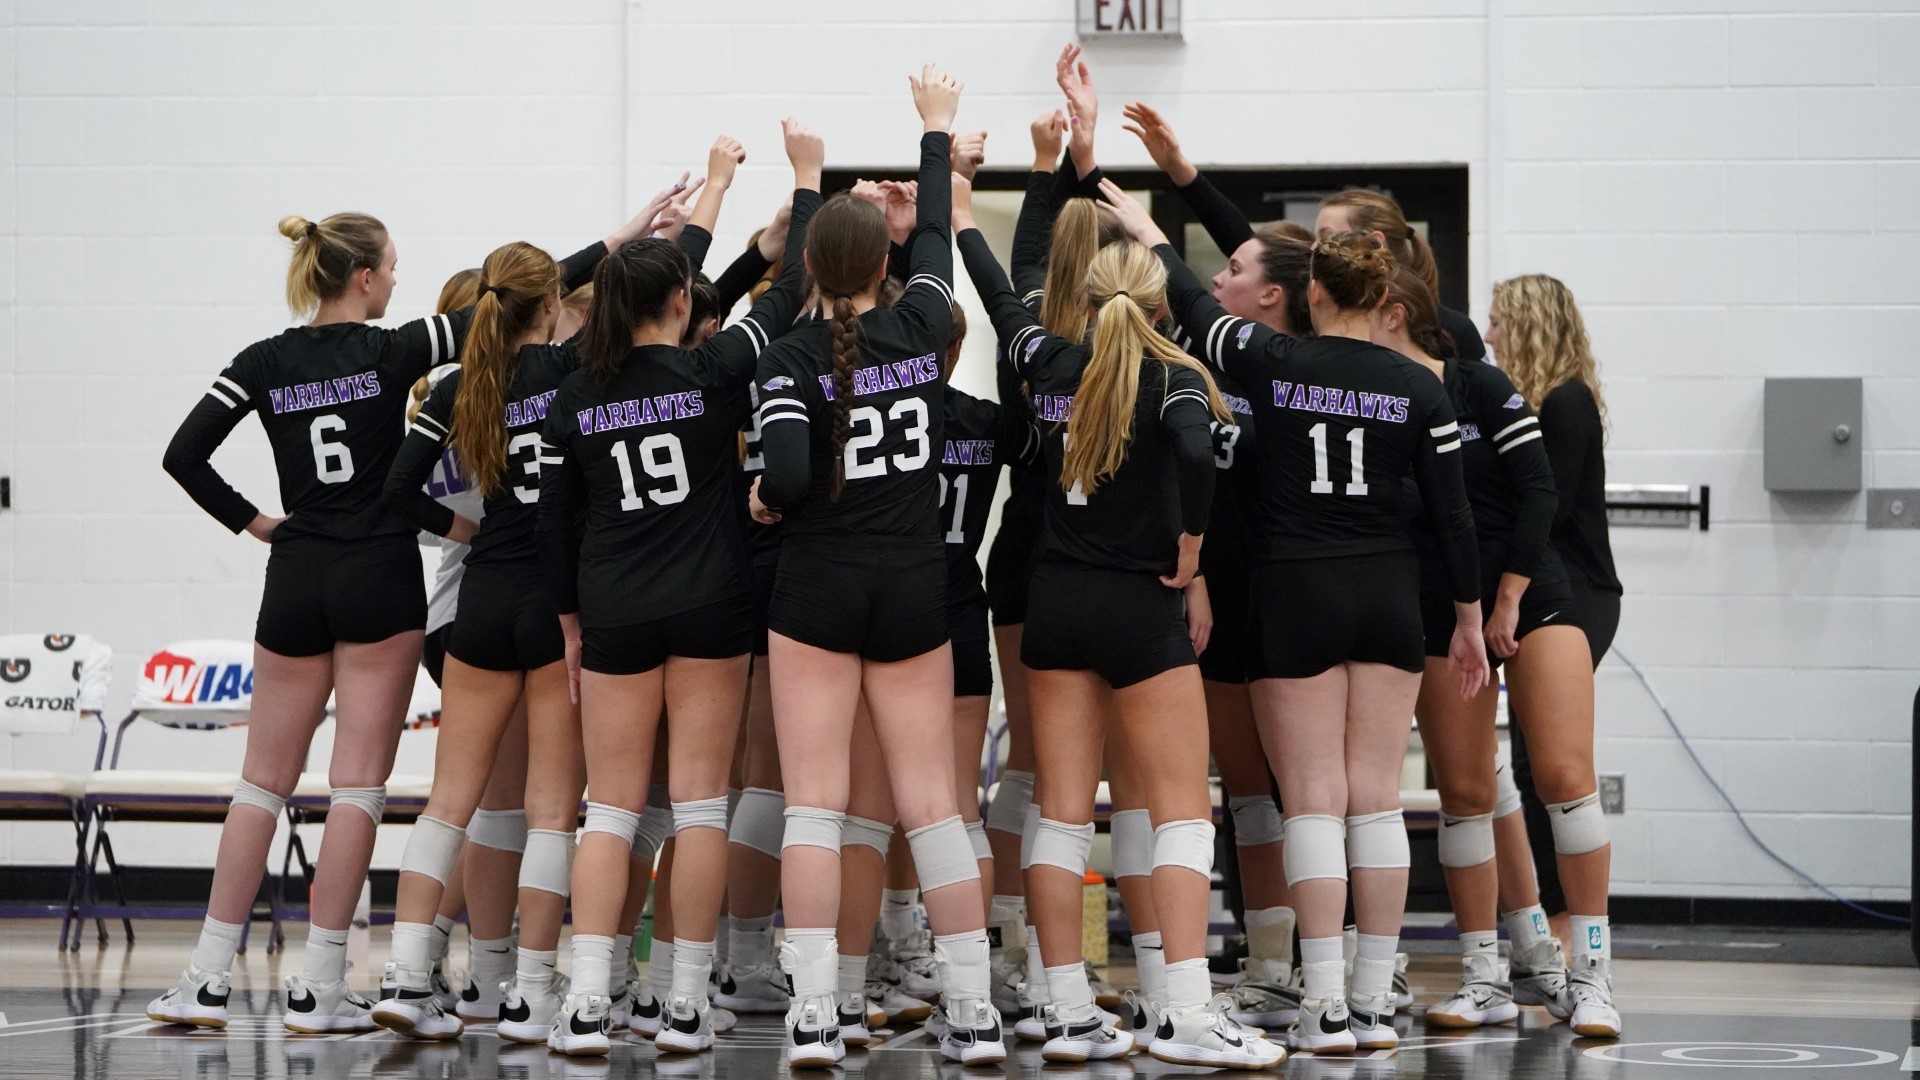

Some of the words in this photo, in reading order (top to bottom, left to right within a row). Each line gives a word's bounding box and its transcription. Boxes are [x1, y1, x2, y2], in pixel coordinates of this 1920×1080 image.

[269, 370, 381, 415] WARHAWKS
[818, 352, 939, 401] WRHAWKS
[1272, 380, 1410, 423] WARHAWKS
[577, 389, 705, 436] WARHAWKS
[844, 396, 930, 480] 23
[309, 413, 355, 484] 6
[610, 432, 691, 512] 19
[1308, 422, 1369, 496] 11
